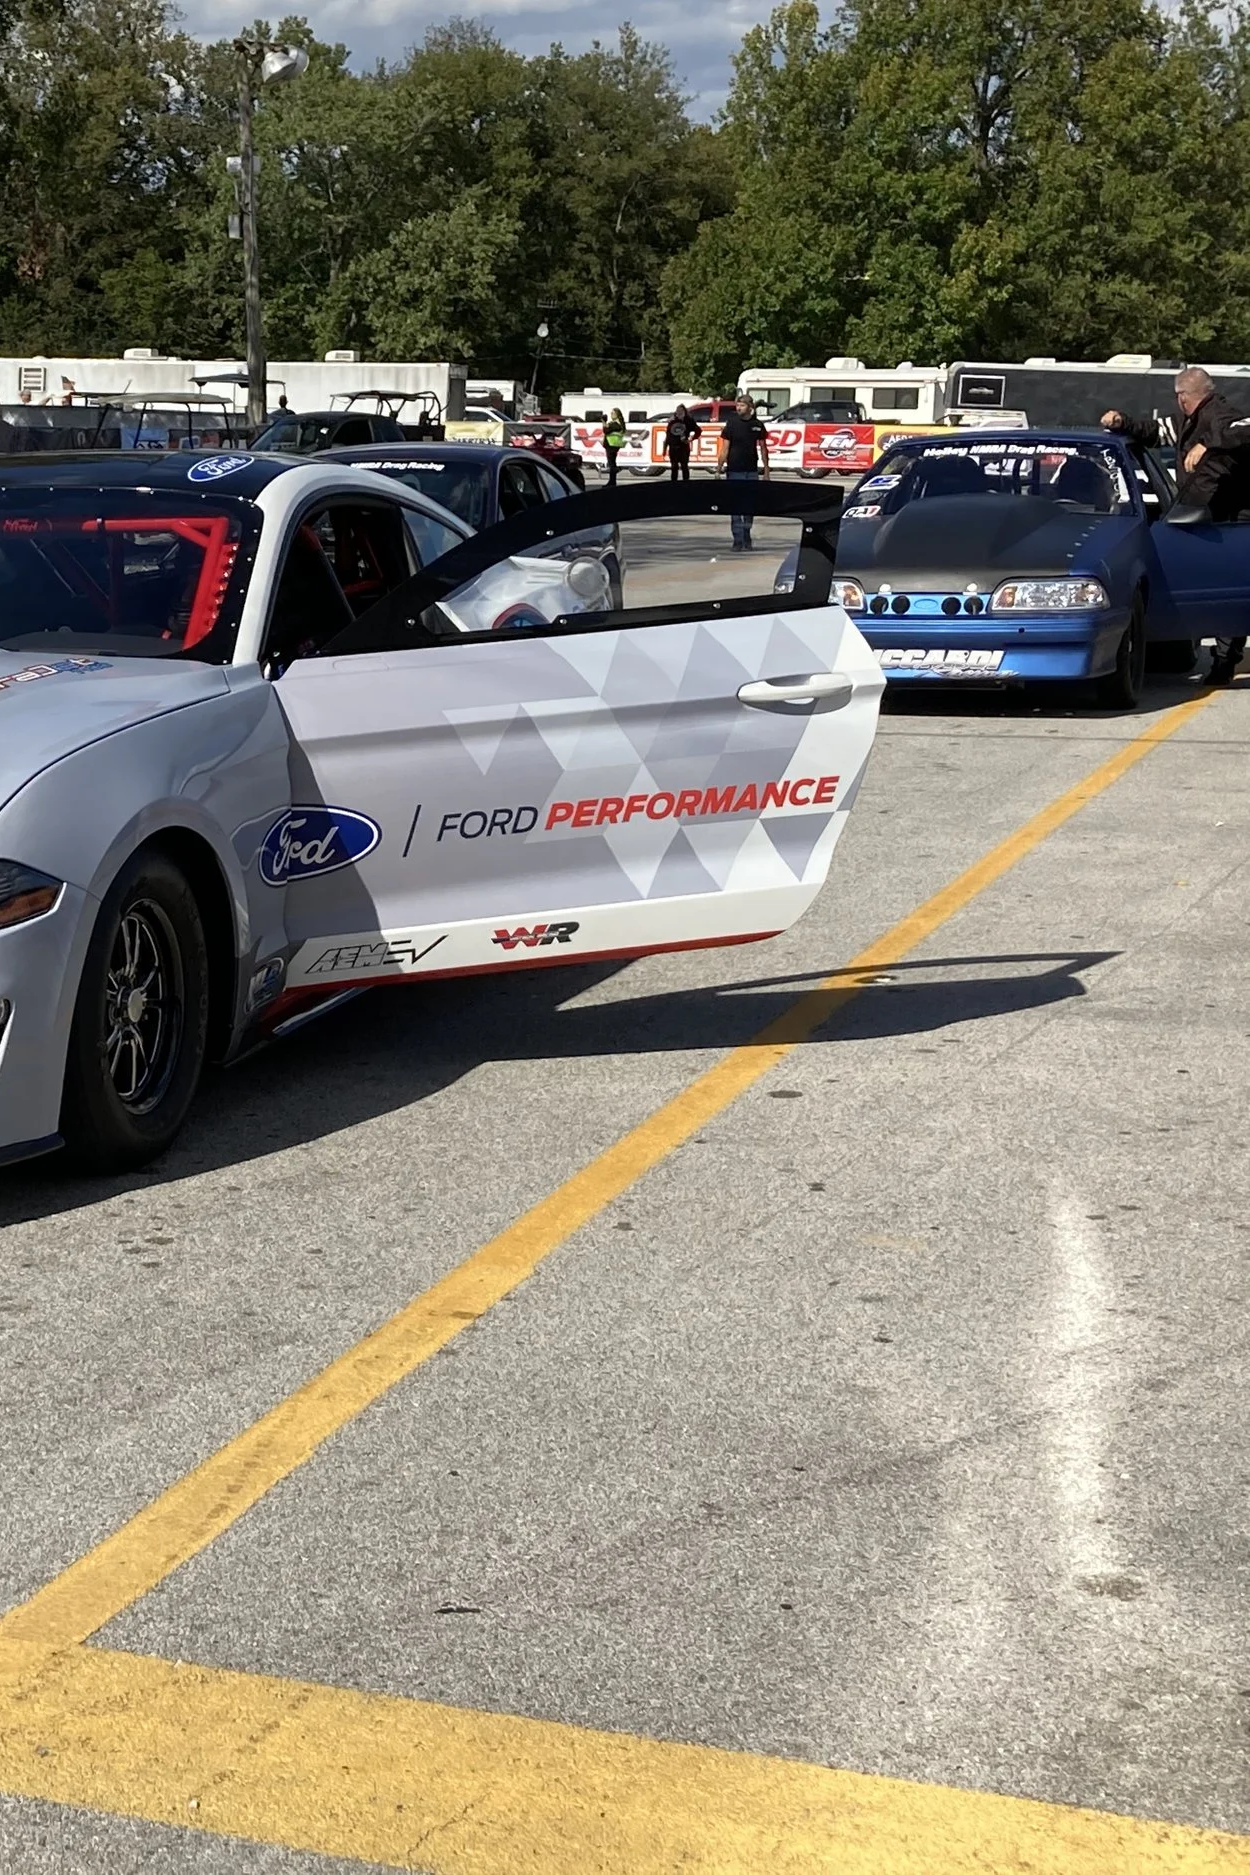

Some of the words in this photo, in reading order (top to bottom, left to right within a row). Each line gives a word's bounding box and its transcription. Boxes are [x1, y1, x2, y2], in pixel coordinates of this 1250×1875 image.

[819, 434, 857, 448] TEN
[923, 446, 969, 457] Holley
[969, 444, 1007, 454] NMRA
[1007, 444, 1036, 455] Drag
[197, 456, 247, 476] Ford
[381, 462, 408, 470] Drag
[407, 462, 446, 471] Racing
[436, 806, 539, 842] FORD
[545, 775, 841, 831] PERFORMANCE
